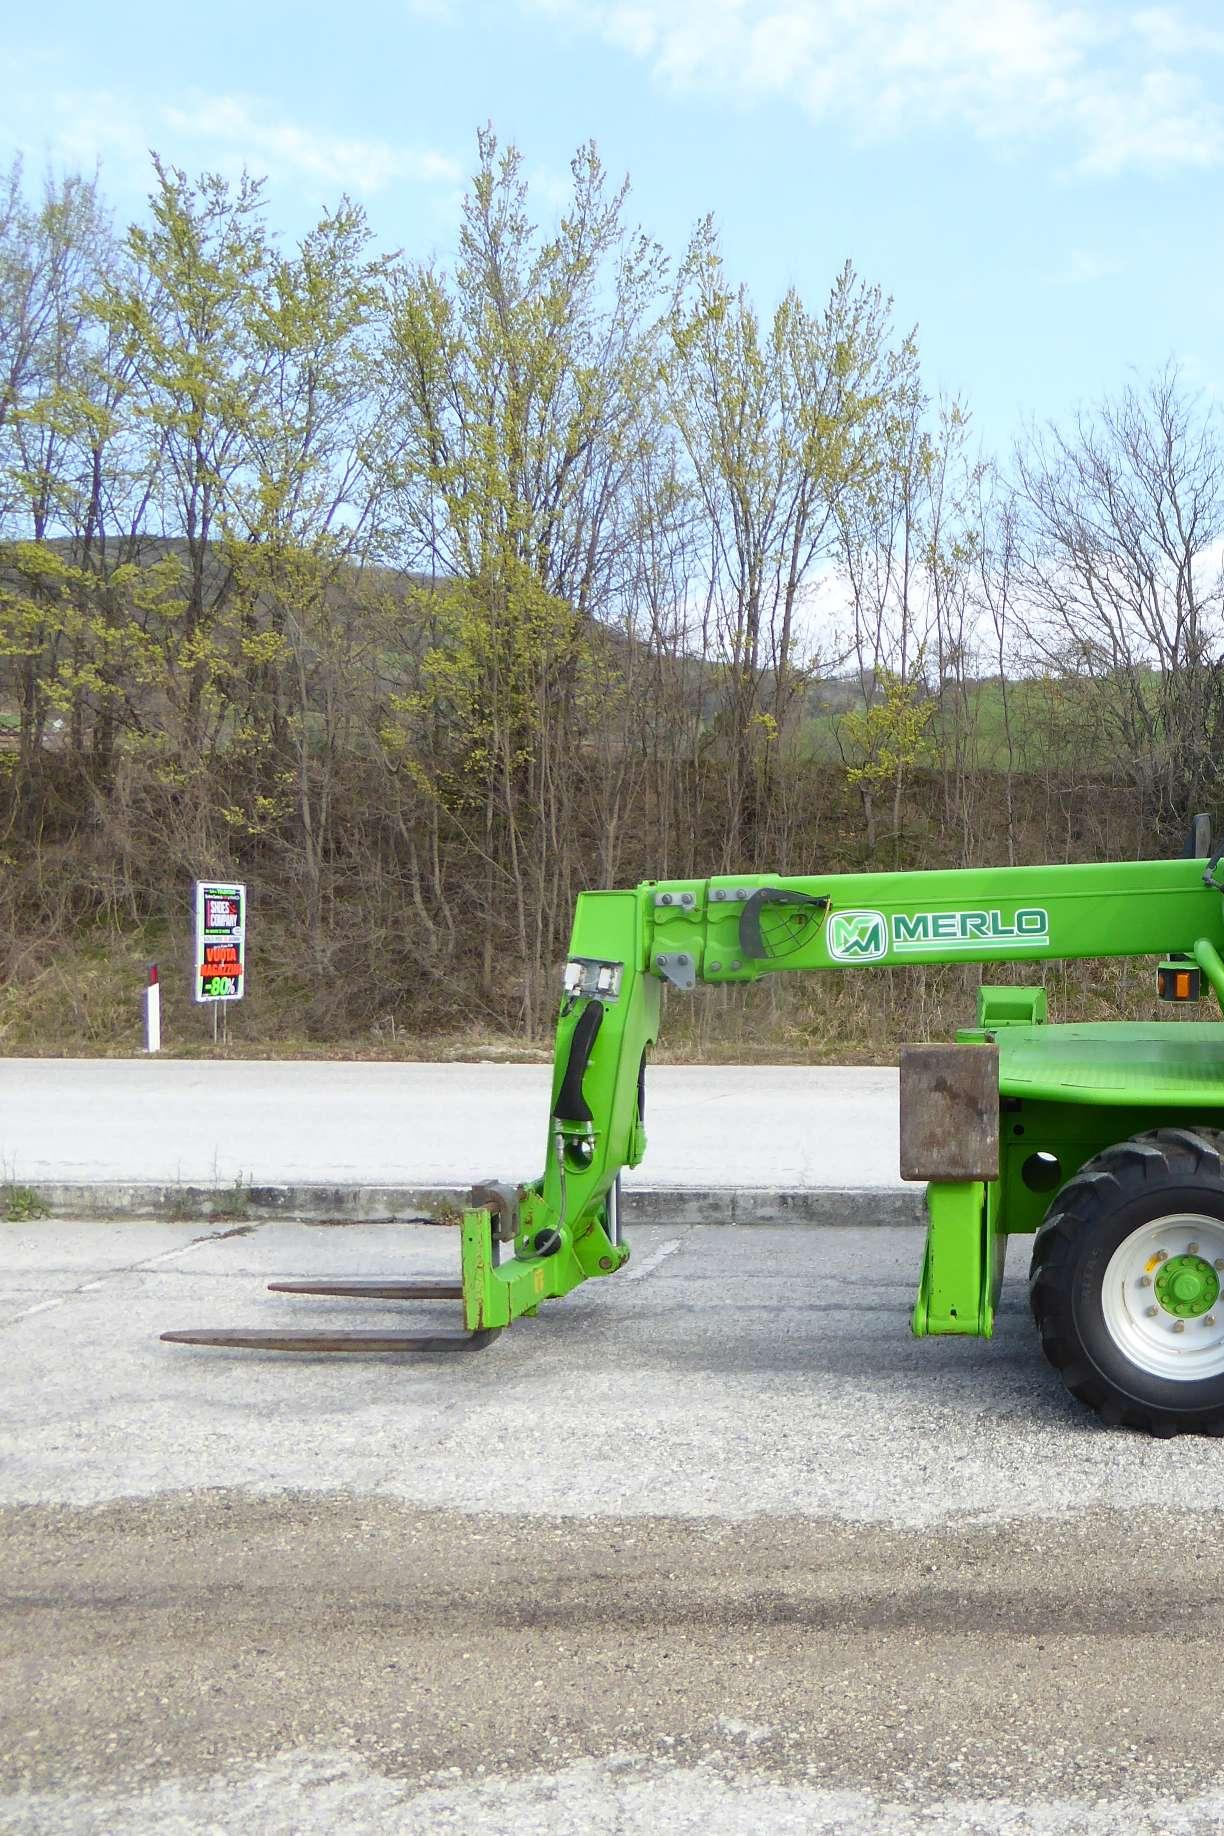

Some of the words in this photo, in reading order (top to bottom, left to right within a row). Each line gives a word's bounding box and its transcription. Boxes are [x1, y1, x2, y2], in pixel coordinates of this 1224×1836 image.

[210, 901, 229, 914] SHOES
[211, 914, 237, 927] COMPANY
[892, 908, 1048, 941] MERLO
[206, 947, 236, 961] VUOTA
[205, 976, 236, 996] -80%
